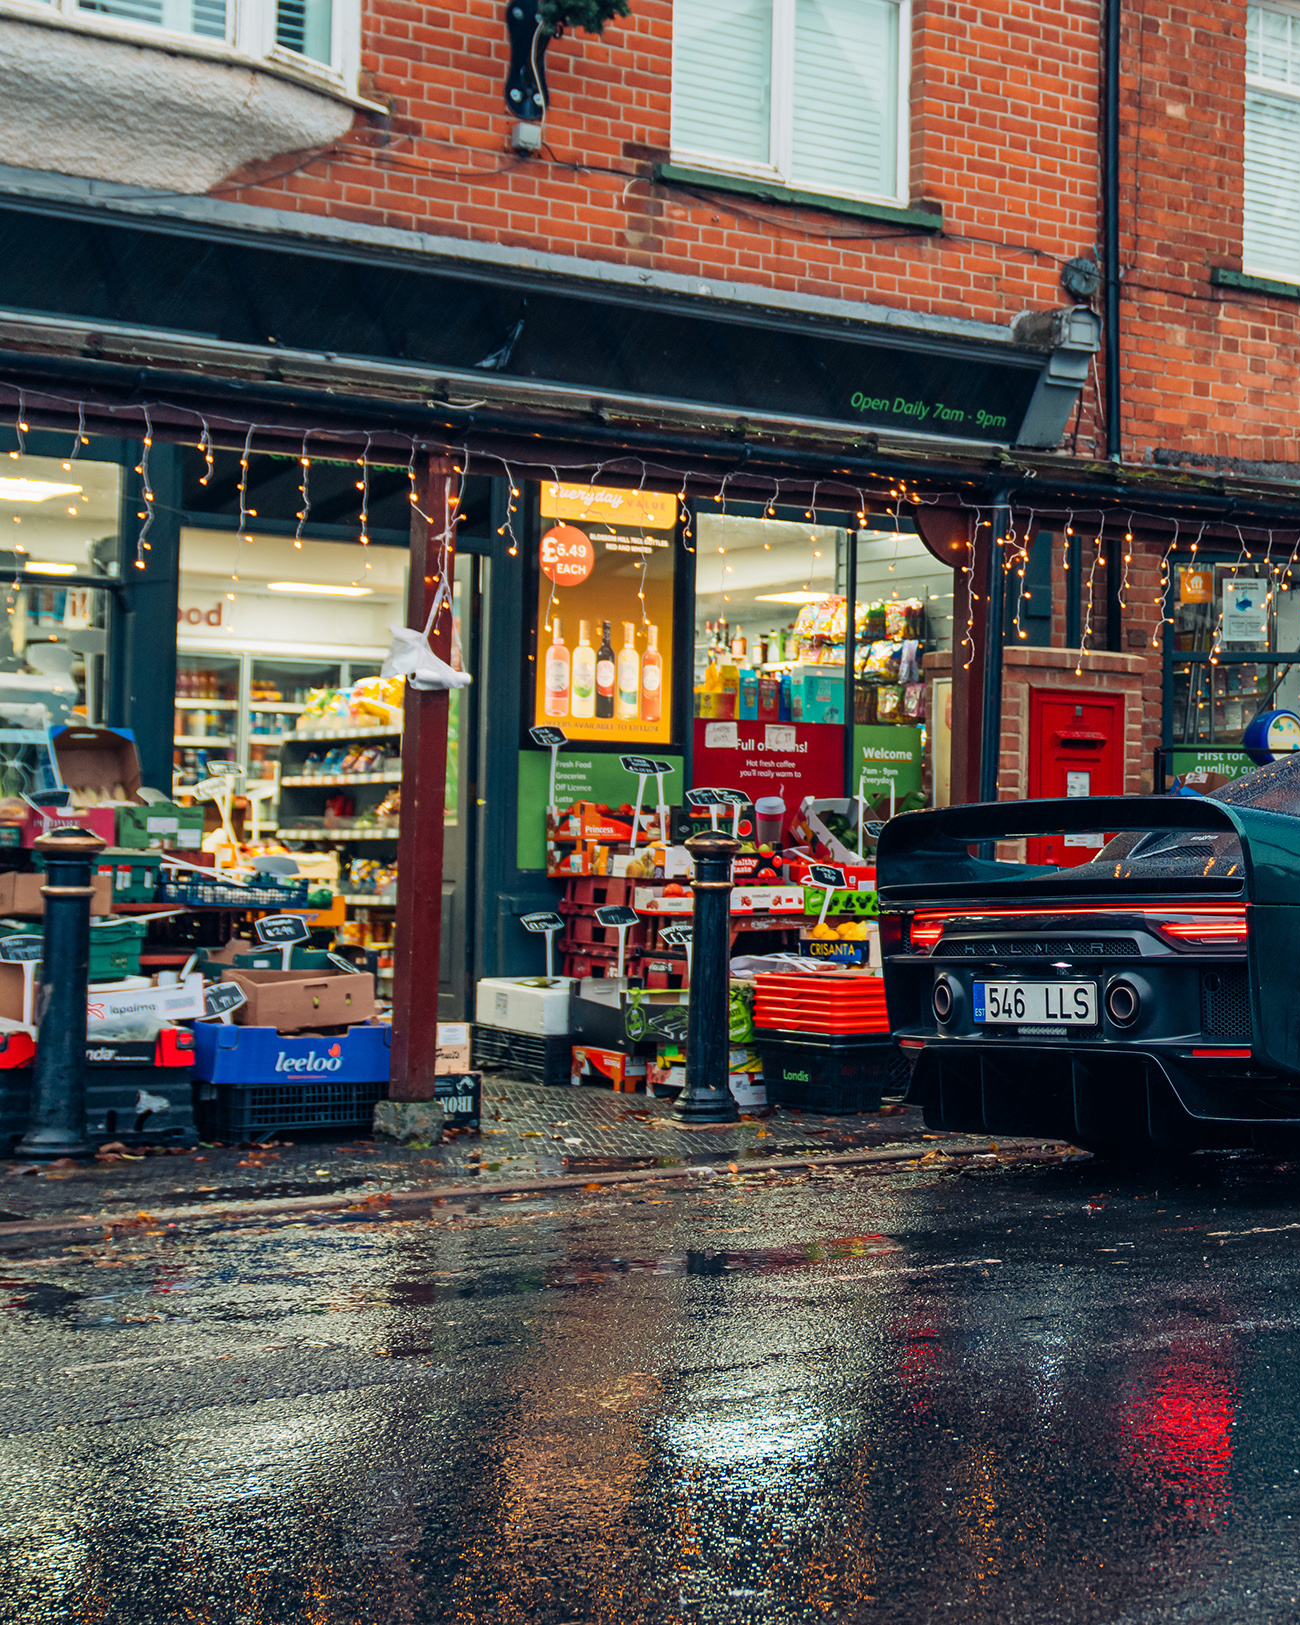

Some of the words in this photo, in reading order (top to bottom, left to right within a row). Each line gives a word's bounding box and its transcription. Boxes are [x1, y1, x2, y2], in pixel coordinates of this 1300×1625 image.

[850, 391, 890, 413] Open
[892, 398, 930, 420] Daily
[932, 403, 964, 422] 7am
[975, 409, 1007, 428] 9pm
[626, 498, 666, 511] VALUE
[542, 536, 587, 563] £6.49
[556, 563, 587, 575] EACH
[573, 722, 615, 731] AVAILABLE
[617, 723, 628, 731] TO
[735, 738, 755, 751] Full
[862, 747, 913, 760] Welcome
[1197, 752, 1224, 761] First
[1227, 752, 1245, 761] for
[575, 761, 592, 769] Food
[746, 759, 758, 767] Hot
[776, 760, 796, 768] coffee
[740, 769, 756, 778] you'll
[757, 769, 775, 778] really
[862, 766, 878, 775] 7am
[882, 767, 898, 777] 9pm
[1194, 763, 1238, 777] quality
[1241, 765, 1260, 774] an
[862, 775, 893, 786] Everyday
[585, 825, 614, 834] Princess
[733, 858, 758, 868] ealthy
[809, 942, 855, 956] CRISANTA
[964, 943, 1104, 954] KALMAR
[109, 1003, 156, 1014] lapalma
[988, 987, 1026, 1019] 546
[1045, 987, 1089, 1019] LLS
[974, 1008, 985, 1017] EST
[86, 1047, 114, 1061] nda
[274, 1051, 342, 1073] leeloo
[783, 1069, 809, 1082] Londis
